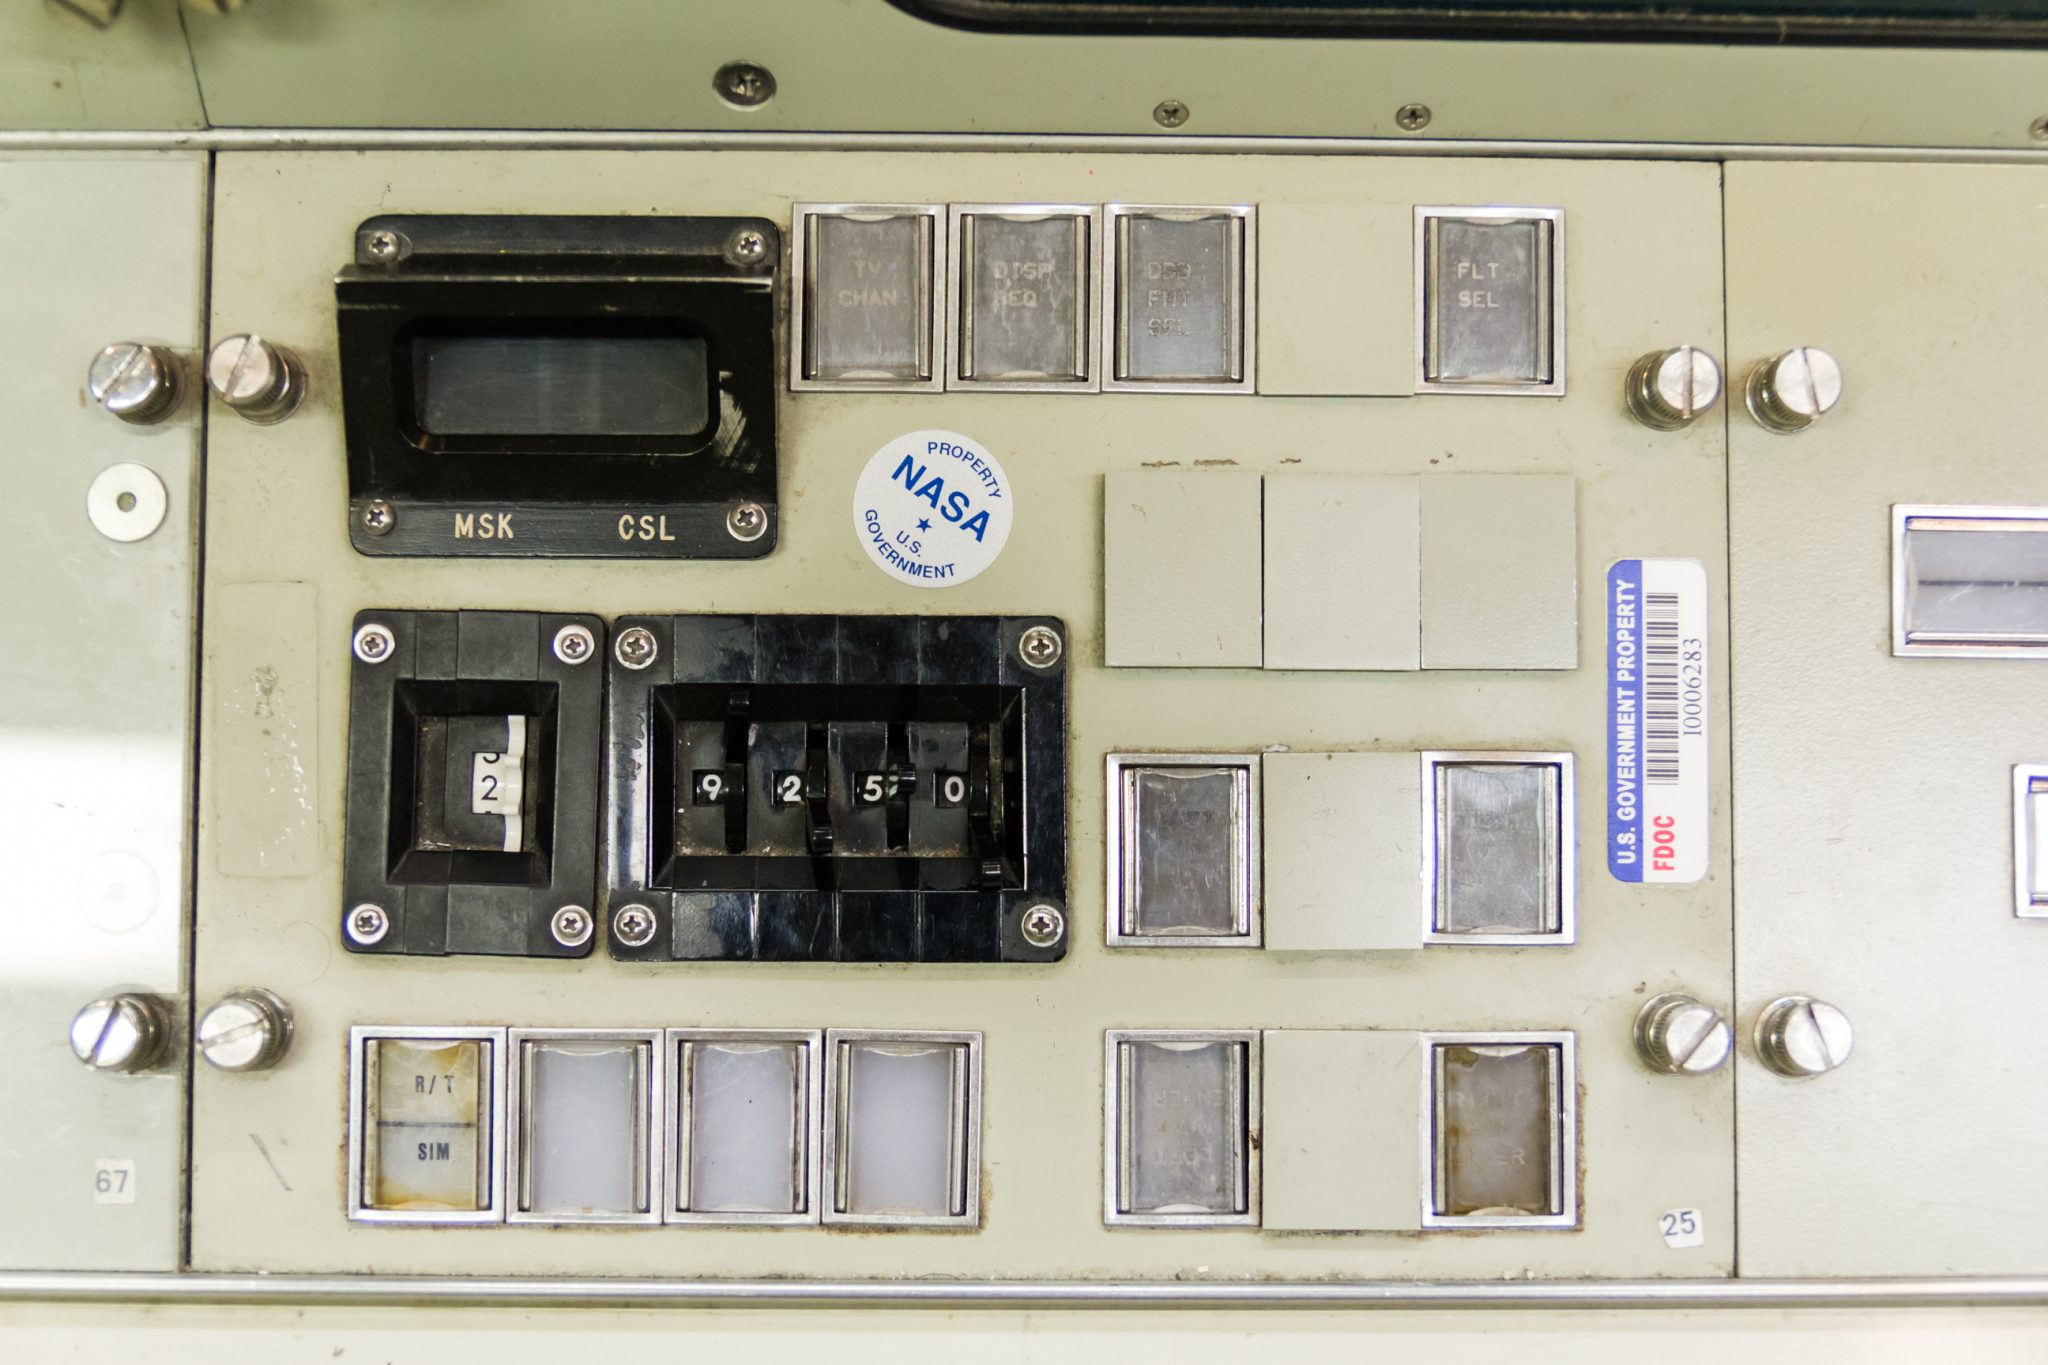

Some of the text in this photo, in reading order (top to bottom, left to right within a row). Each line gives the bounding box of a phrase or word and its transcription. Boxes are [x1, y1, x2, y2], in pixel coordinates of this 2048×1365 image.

[1456, 261, 1500, 280] FLT
[838, 289, 897, 307] CHAN
[1457, 289, 1501, 308] SEL
[927, 441, 1002, 499] PROPERTY
[891, 454, 990, 542] NASA
[453, 512, 515, 539] MSK
[617, 514, 676, 541] CSL
[864, 509, 956, 579] GOVERNMENT
[896, 530, 922, 558] U.S.
[1616, 579, 1636, 865] U.S. GOVERNMENT PROPERTY
[481, 774, 498, 801] 2
[1652, 814, 1675, 871] FDOC
[417, 1142, 450, 1161] SIM
[95, 1168, 128, 1193] 67
[1662, 1210, 1696, 1237] 25
